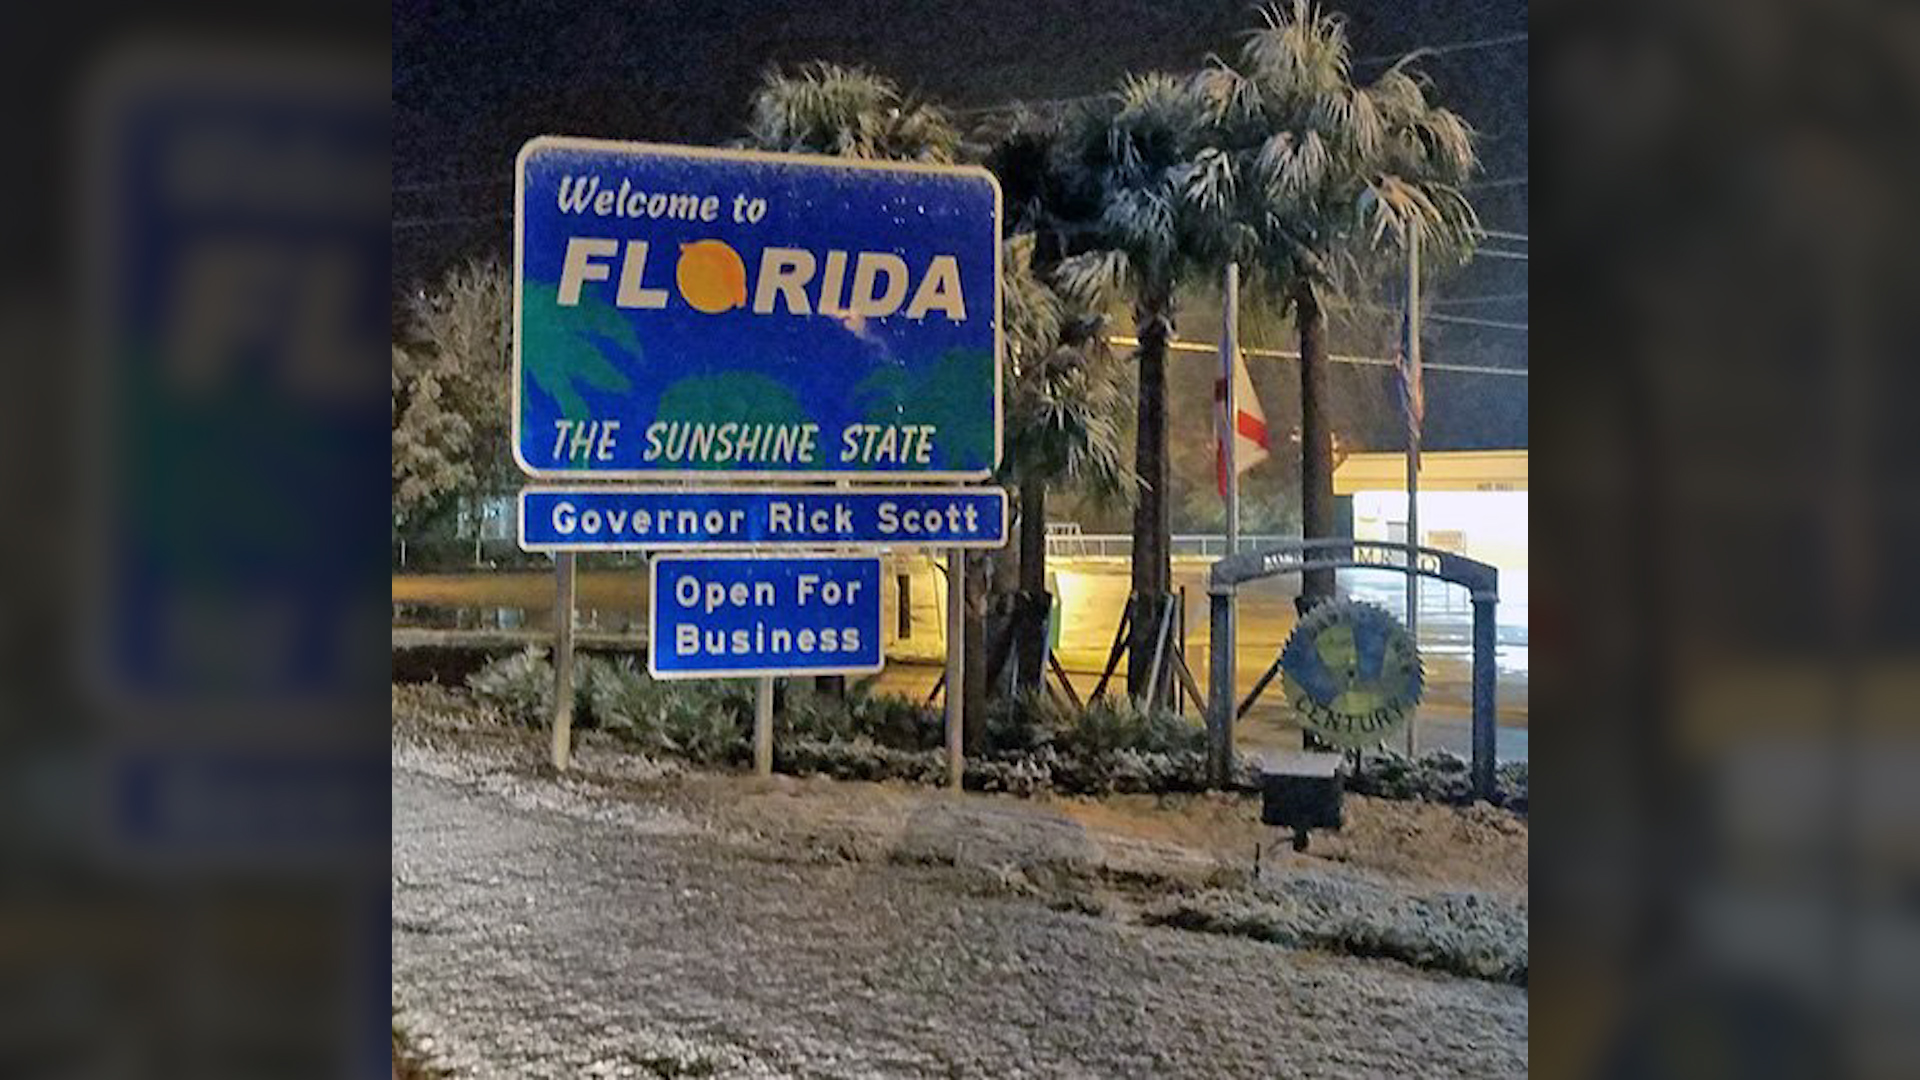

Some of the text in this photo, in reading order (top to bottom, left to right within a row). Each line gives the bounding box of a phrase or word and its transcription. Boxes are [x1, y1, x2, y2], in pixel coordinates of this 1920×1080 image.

[557, 175, 767, 224] Welcome to
[556, 237, 967, 321] FLORIDA
[553, 419, 936, 464] THE SUNSHINE STATE
[552, 502, 979, 534] Governor Rick Scott
[675, 575, 862, 614] Open For
[675, 622, 861, 655] Business
[1296, 695, 1404, 734] CENTURY
